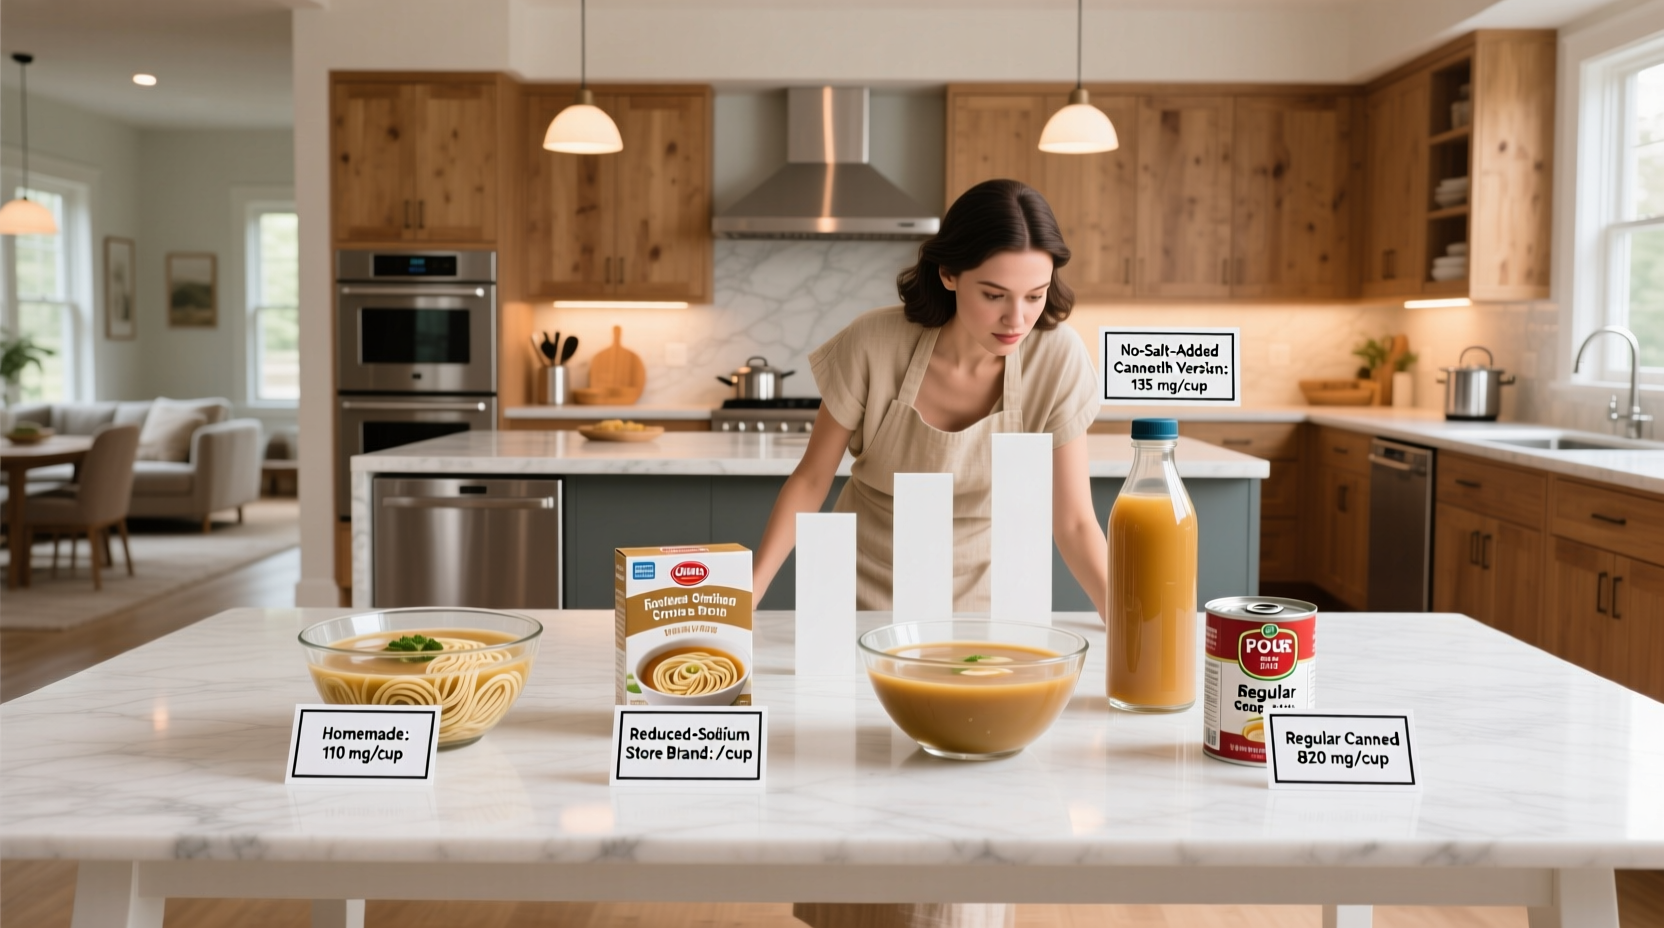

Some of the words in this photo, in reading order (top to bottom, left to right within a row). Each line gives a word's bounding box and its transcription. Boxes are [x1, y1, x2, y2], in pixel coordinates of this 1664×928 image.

[1121, 343, 1219, 357] No-Salt-Added
[1131, 378, 1153, 391] 135
[1157, 378, 1208, 395] mg/cup
[322, 726, 410, 741] Homemade:
[629, 726, 750, 741] Reduced-Sodium
[1285, 730, 1341, 749] Regular
[1344, 731, 1400, 746] Canned
[322, 745, 345, 760] 110
[348, 744, 403, 764] mg/cup
[625, 745, 663, 760] Store
[666, 745, 713, 760] Brand:
[716, 744, 753, 763] /cup
[1297, 750, 1327, 764] 820
[1331, 750, 1390, 769] mg/cup
